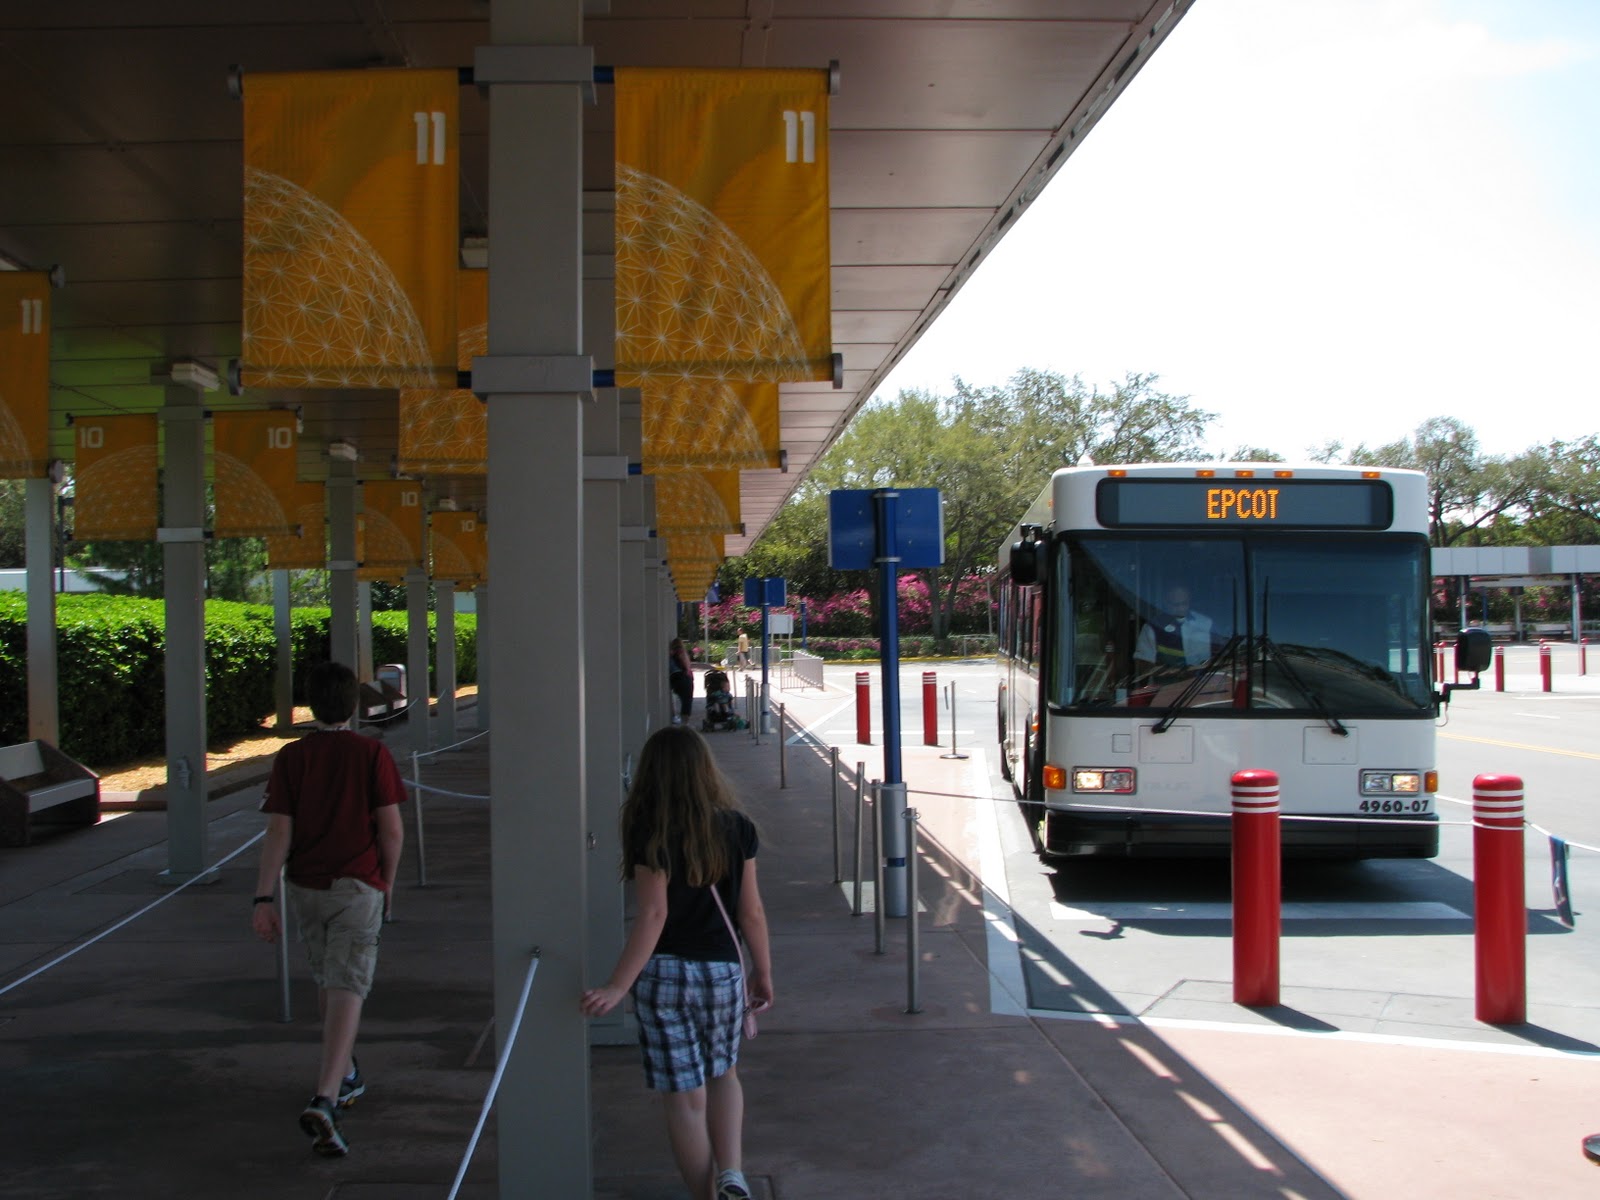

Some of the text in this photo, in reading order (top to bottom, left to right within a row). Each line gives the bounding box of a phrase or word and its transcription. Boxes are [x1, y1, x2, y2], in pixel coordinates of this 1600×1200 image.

[413, 112, 446, 165] 11
[783, 111, 815, 163] 11
[21, 299, 42, 335] 11
[80, 427, 104, 448] 10
[267, 427, 292, 449] 10
[401, 491, 418, 506] 10
[1207, 488, 1280, 519] EPCOT
[461, 520, 475, 532] 10
[1359, 800, 1429, 812] 4960-07
